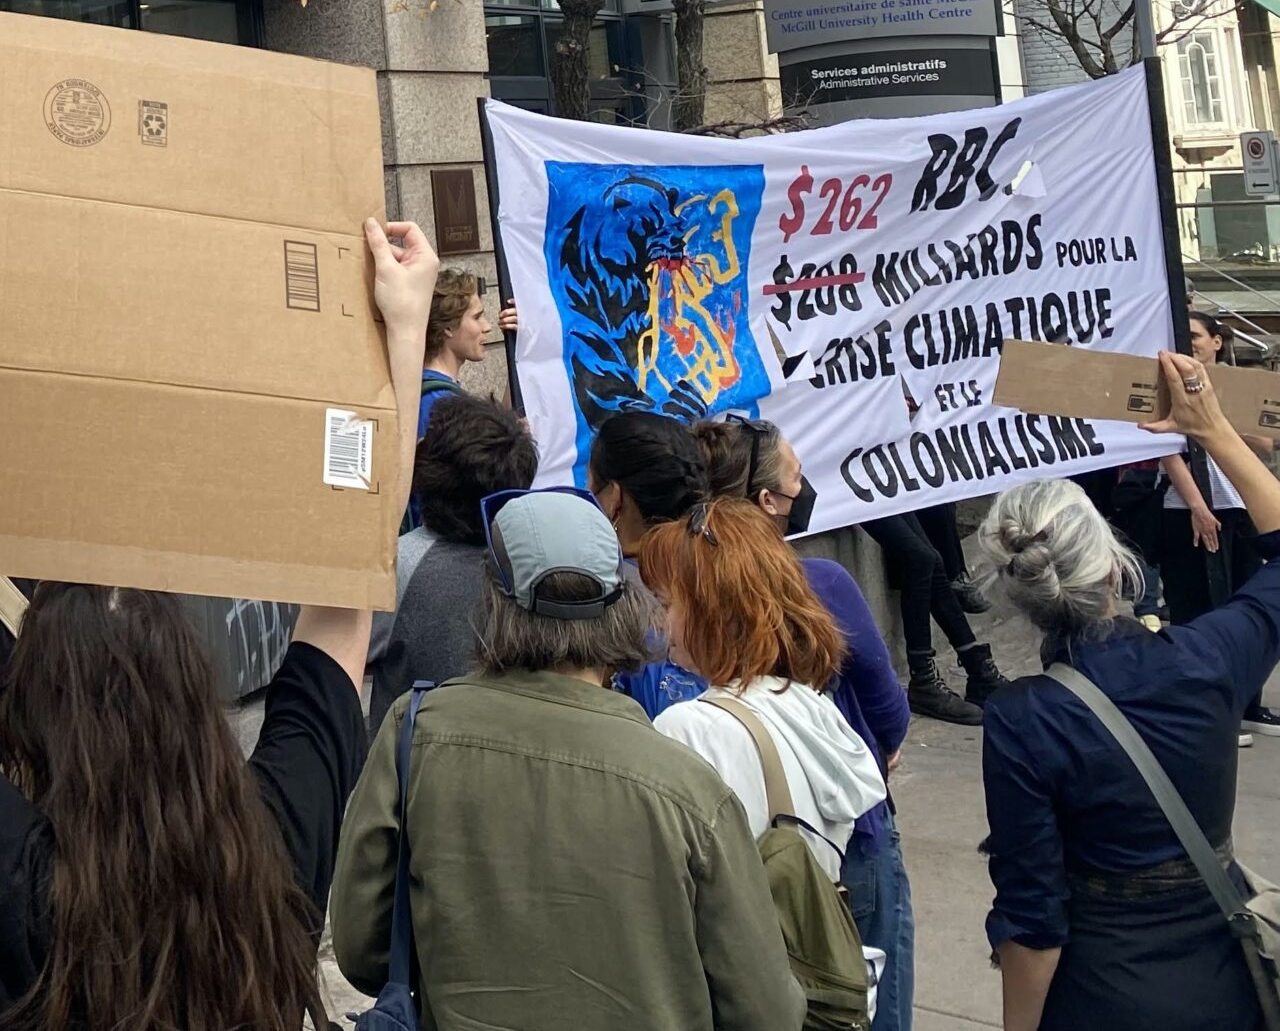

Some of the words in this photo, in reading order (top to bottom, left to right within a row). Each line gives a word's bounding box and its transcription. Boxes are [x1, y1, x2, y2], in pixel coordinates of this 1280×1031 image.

[771, 10, 803, 21] Centre
[781, 20, 816, 34] McGill
[819, 15, 878, 30] University
[882, 11, 924, 24] Health
[928, 6, 973, 19] Centre
[811, 66, 858, 79] Services
[861, 59, 947, 75] administratifs
[819, 75, 890, 90] Administrative
[892, 72, 940, 84] Services
[779, 165, 893, 243] $262
[1056, 241, 1106, 267] POUR
[1110, 236, 1138, 262] LA
[903, 288, 1114, 369] CLIMATIQUE
[934, 384, 959, 412] ET
[962, 379, 982, 407] LE
[840, 414, 1105, 503] COLONIALISME
